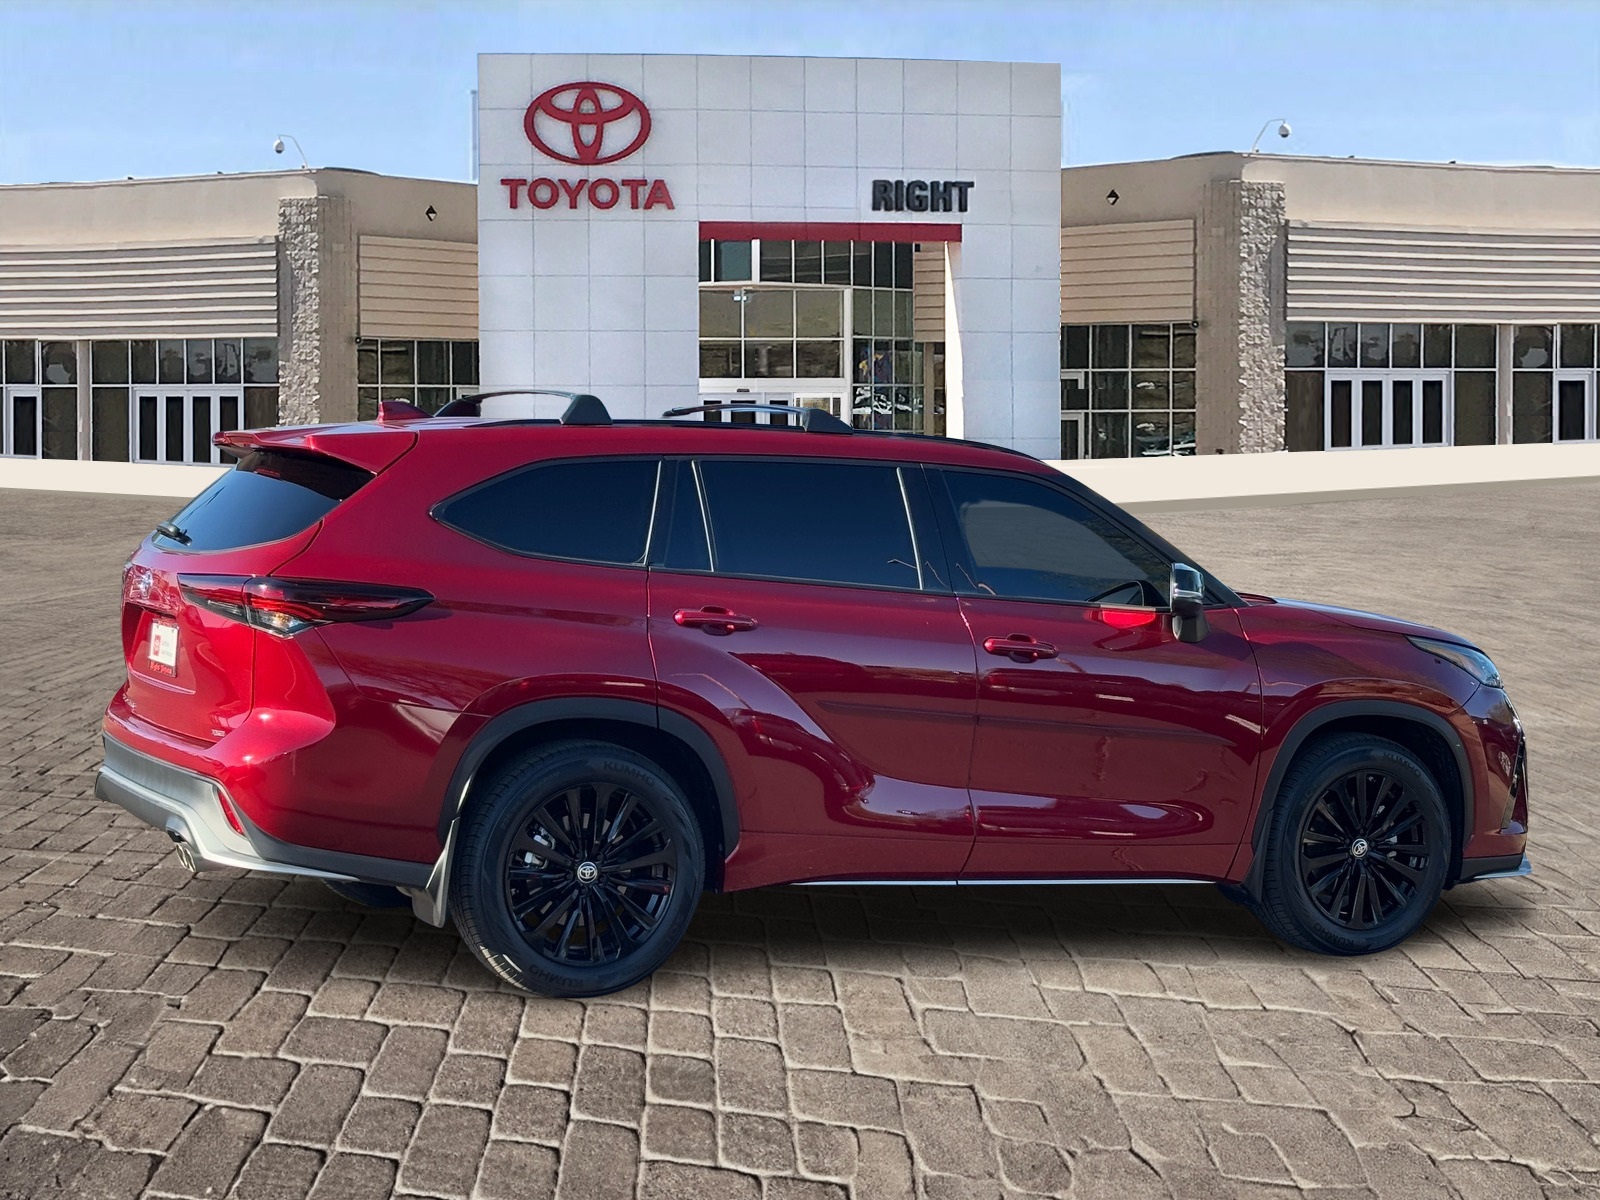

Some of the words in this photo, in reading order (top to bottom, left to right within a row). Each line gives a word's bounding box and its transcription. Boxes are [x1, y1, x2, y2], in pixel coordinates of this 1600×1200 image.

[500, 177, 675, 210] TOYOTA
[872, 179, 975, 213] RIGHT
[603, 760, 655, 787] KUMHO
[528, 963, 584, 987] KUMHO
